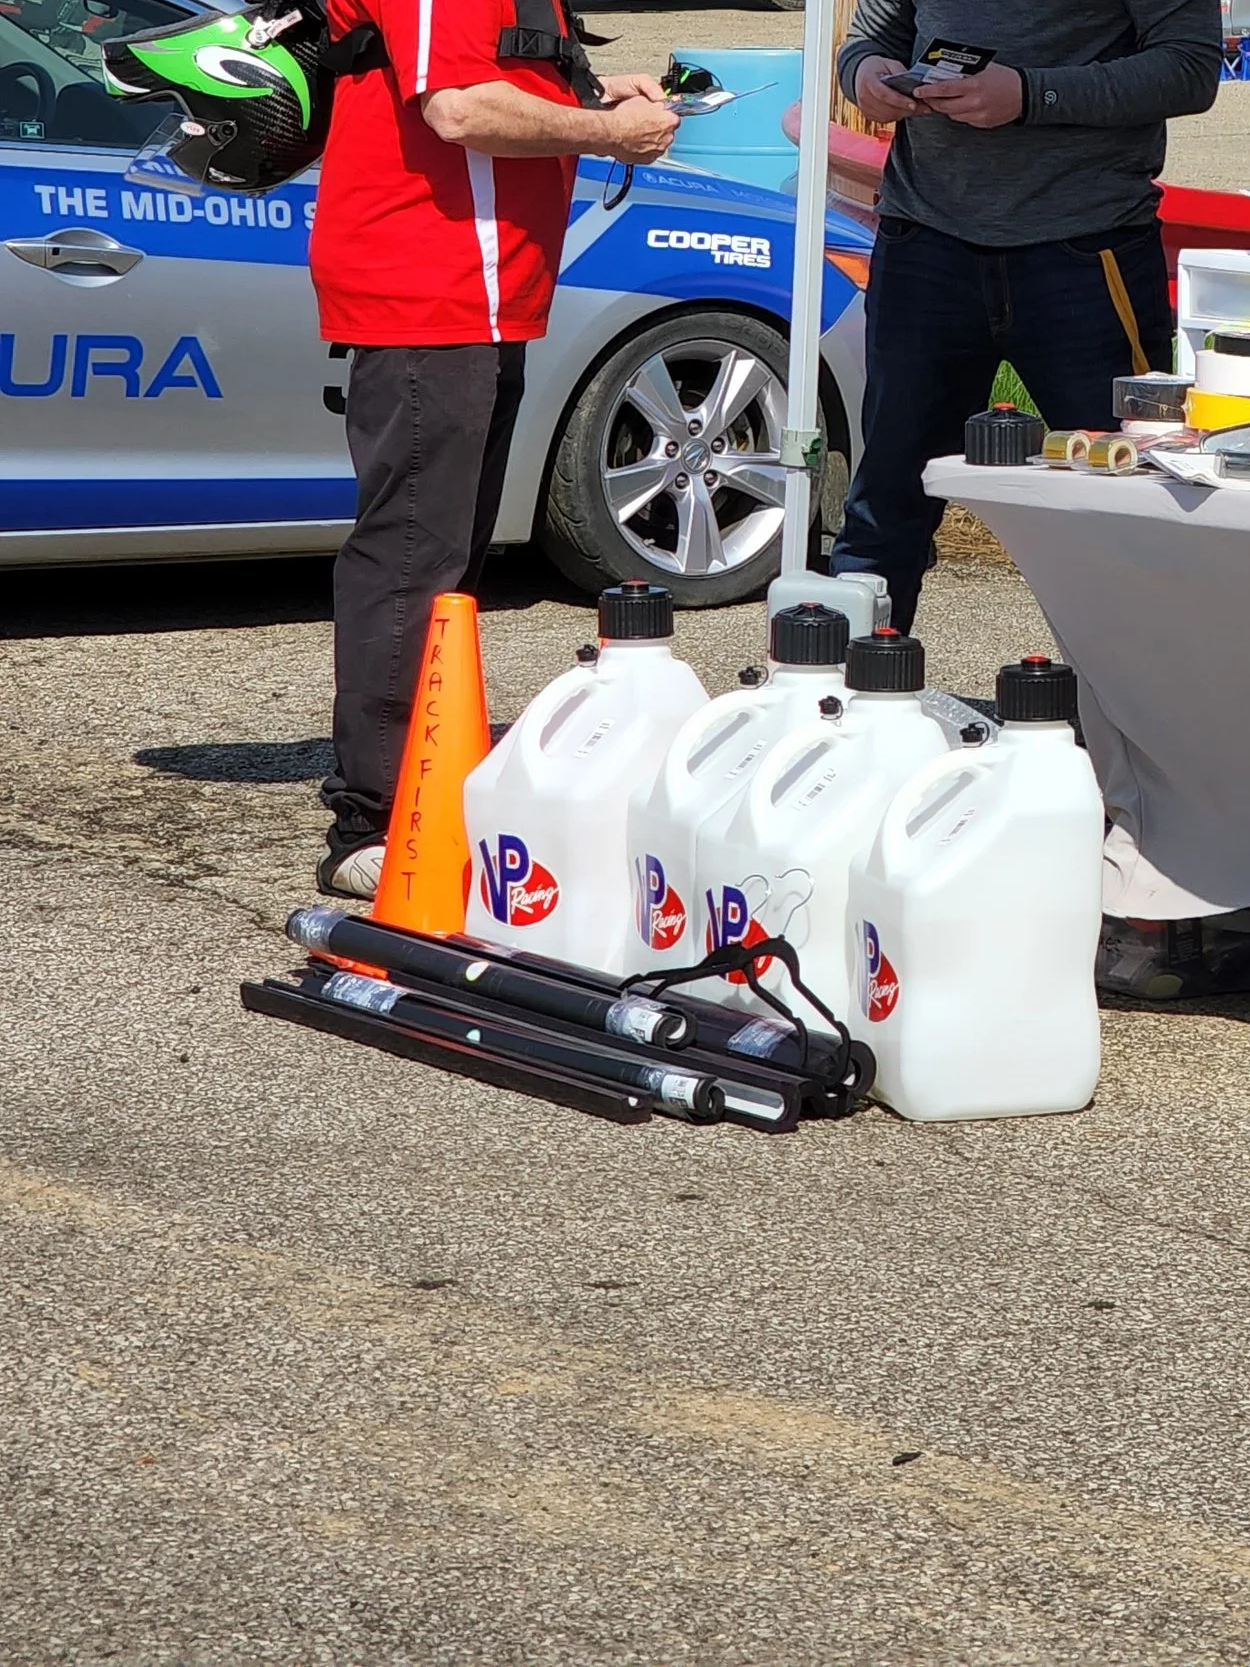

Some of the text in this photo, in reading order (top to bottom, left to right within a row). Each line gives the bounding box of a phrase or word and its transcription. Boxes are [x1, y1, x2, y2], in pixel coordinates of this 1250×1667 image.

[34, 184, 109, 219] THE
[120, 190, 292, 229] MID-OHIO
[647, 229, 771, 256] COOPER
[710, 250, 771, 268] TIRES
[425, 618, 450, 746] TRACK
[402, 759, 432, 900] FIRST
[478, 834, 530, 925] VP
[510, 884, 560, 915] Racing
[635, 853, 666, 947] VP
[651, 908, 688, 938] Racing
